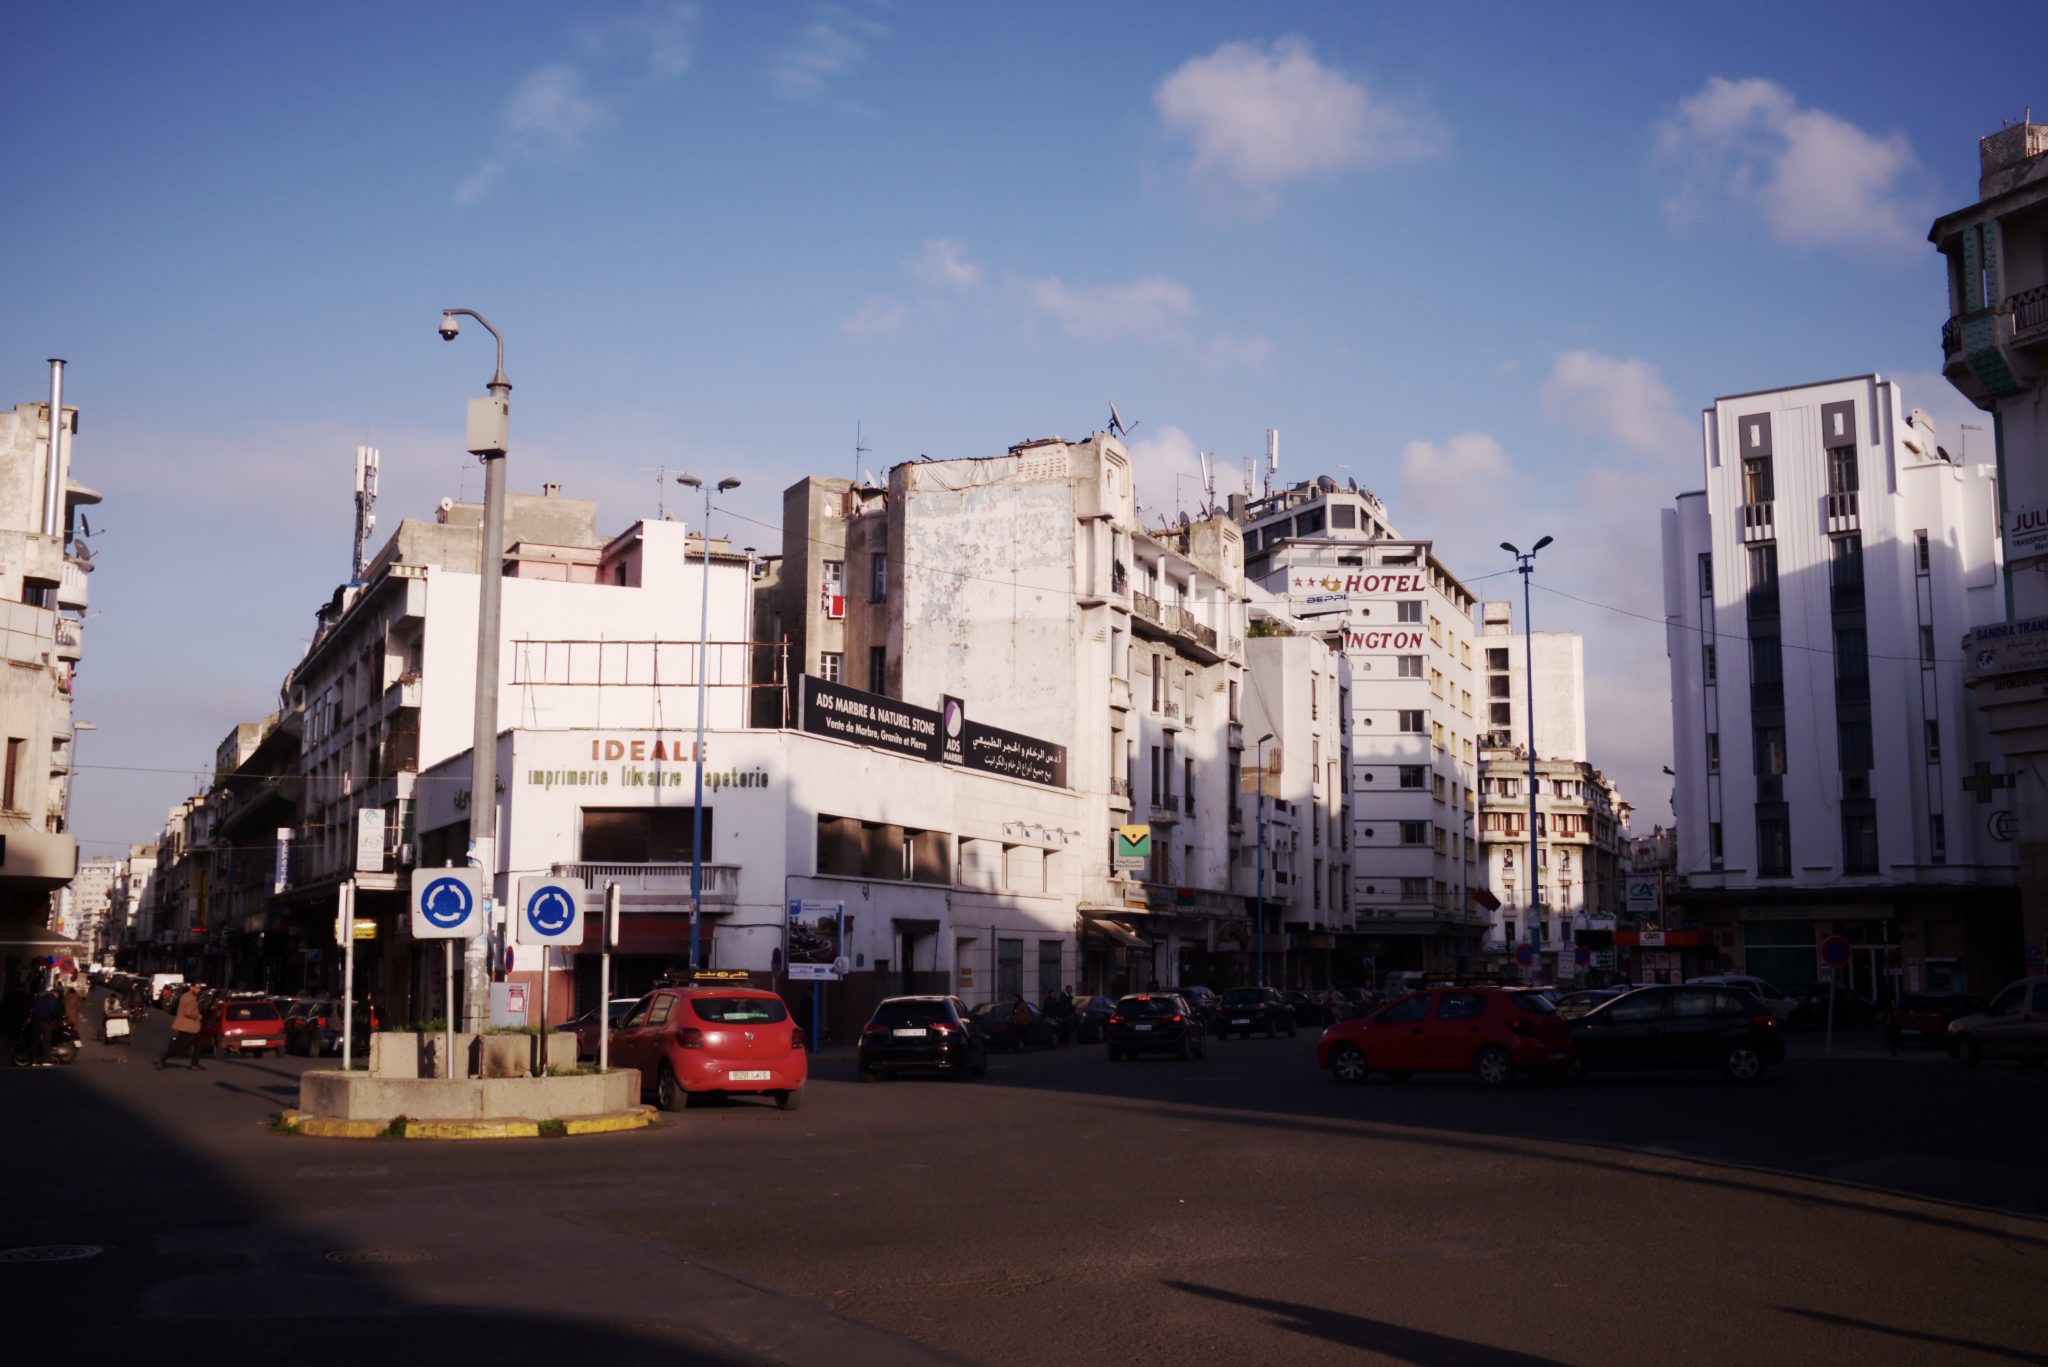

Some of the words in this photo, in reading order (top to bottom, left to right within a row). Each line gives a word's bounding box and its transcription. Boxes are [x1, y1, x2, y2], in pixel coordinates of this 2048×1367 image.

[1345, 575, 1425, 592] HOTEL
[1976, 625, 2015, 641] SANDRA
[816, 693, 833, 710] ADS
[836, 697, 868, 718] MARBRE
[870, 707, 876, 720] &
[878, 708, 911, 730] NATUREL
[912, 717, 935, 736] STONE
[826, 716, 844, 731] Vente
[846, 721, 854, 733] de
[855, 724, 880, 741] Marbre,
[881, 729, 902, 744] Granite
[904, 738, 910, 747] et
[911, 737, 927, 750] Pierre
[592, 740, 707, 762] IDEALE
[946, 738, 960, 752] ADS
[972, 736, 1002, 750] الطبيعي
[1003, 741, 1020, 753] الحجر
[944, 752, 963, 764] MARBRE
[1026, 746, 1044, 761] الرخام
[528, 767, 608, 791] imprimerie
[703, 767, 769, 792] apeterie
